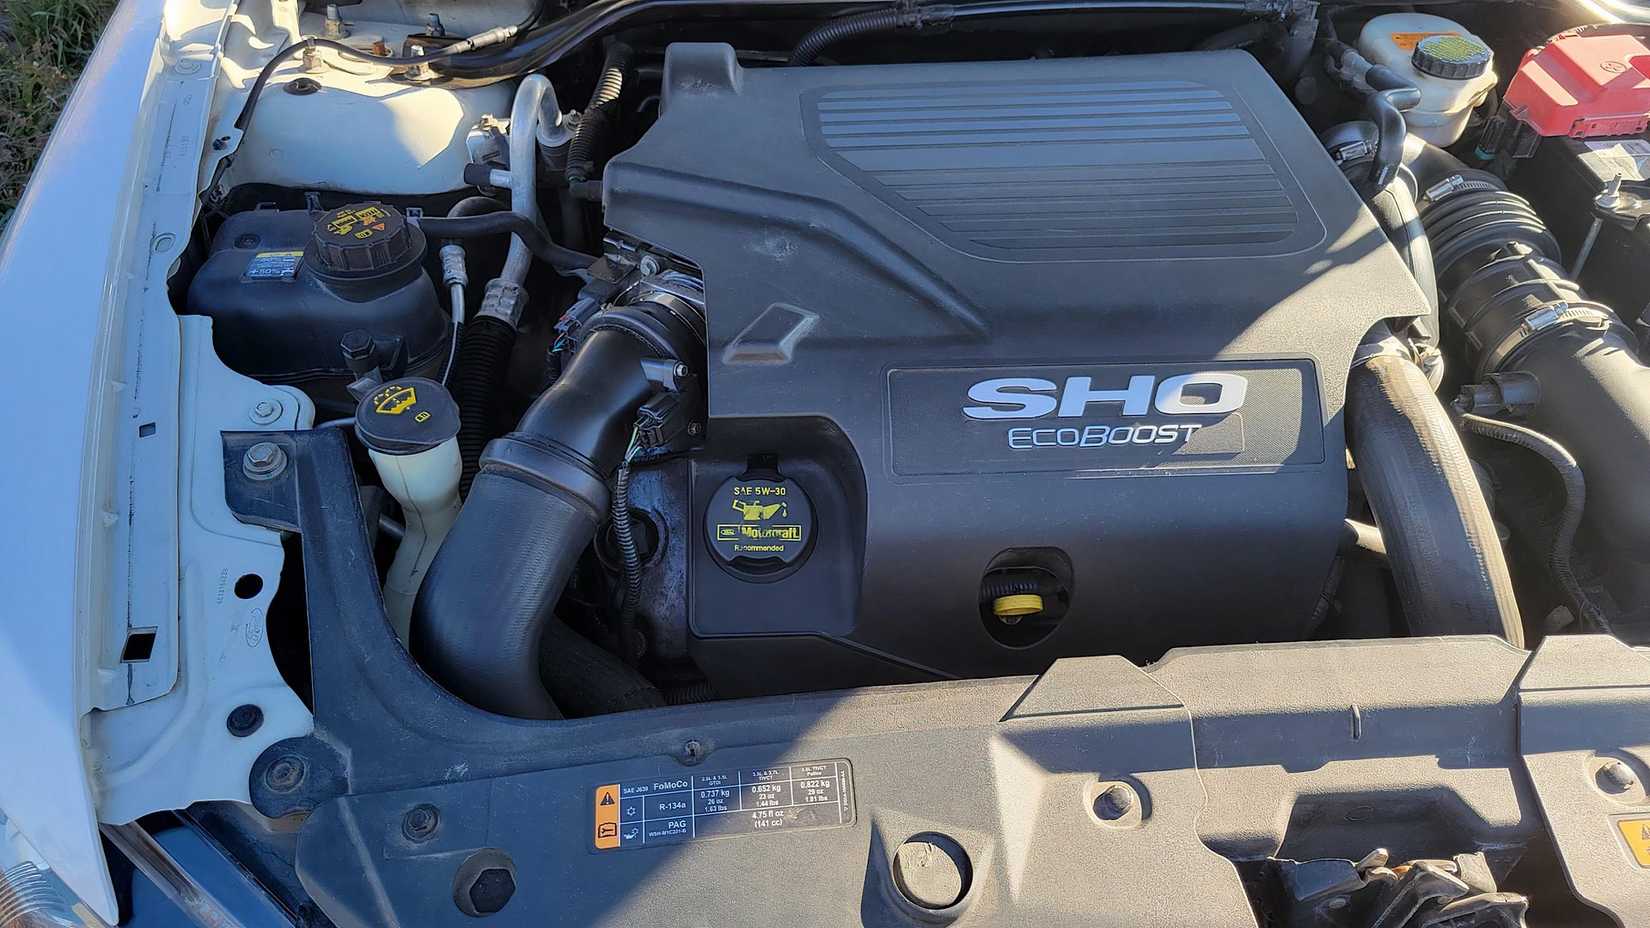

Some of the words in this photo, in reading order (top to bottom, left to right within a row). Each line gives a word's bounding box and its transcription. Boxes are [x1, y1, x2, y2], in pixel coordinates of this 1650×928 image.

[963, 373, 1248, 420] SHO
[734, 486, 752, 496] SAE
[755, 486, 786, 496] 5W-30
[653, 780, 688, 790] FoMoCo
[821, 780, 830, 788] kg
[701, 790, 719, 799] 0.737
[721, 790, 730, 798] kg
[659, 802, 687, 810] R-134a
[752, 811, 767, 819] 4.75
[668, 820, 687, 829] PAG
[754, 820, 769, 828] (141
[771, 818, 783, 826] cc)
